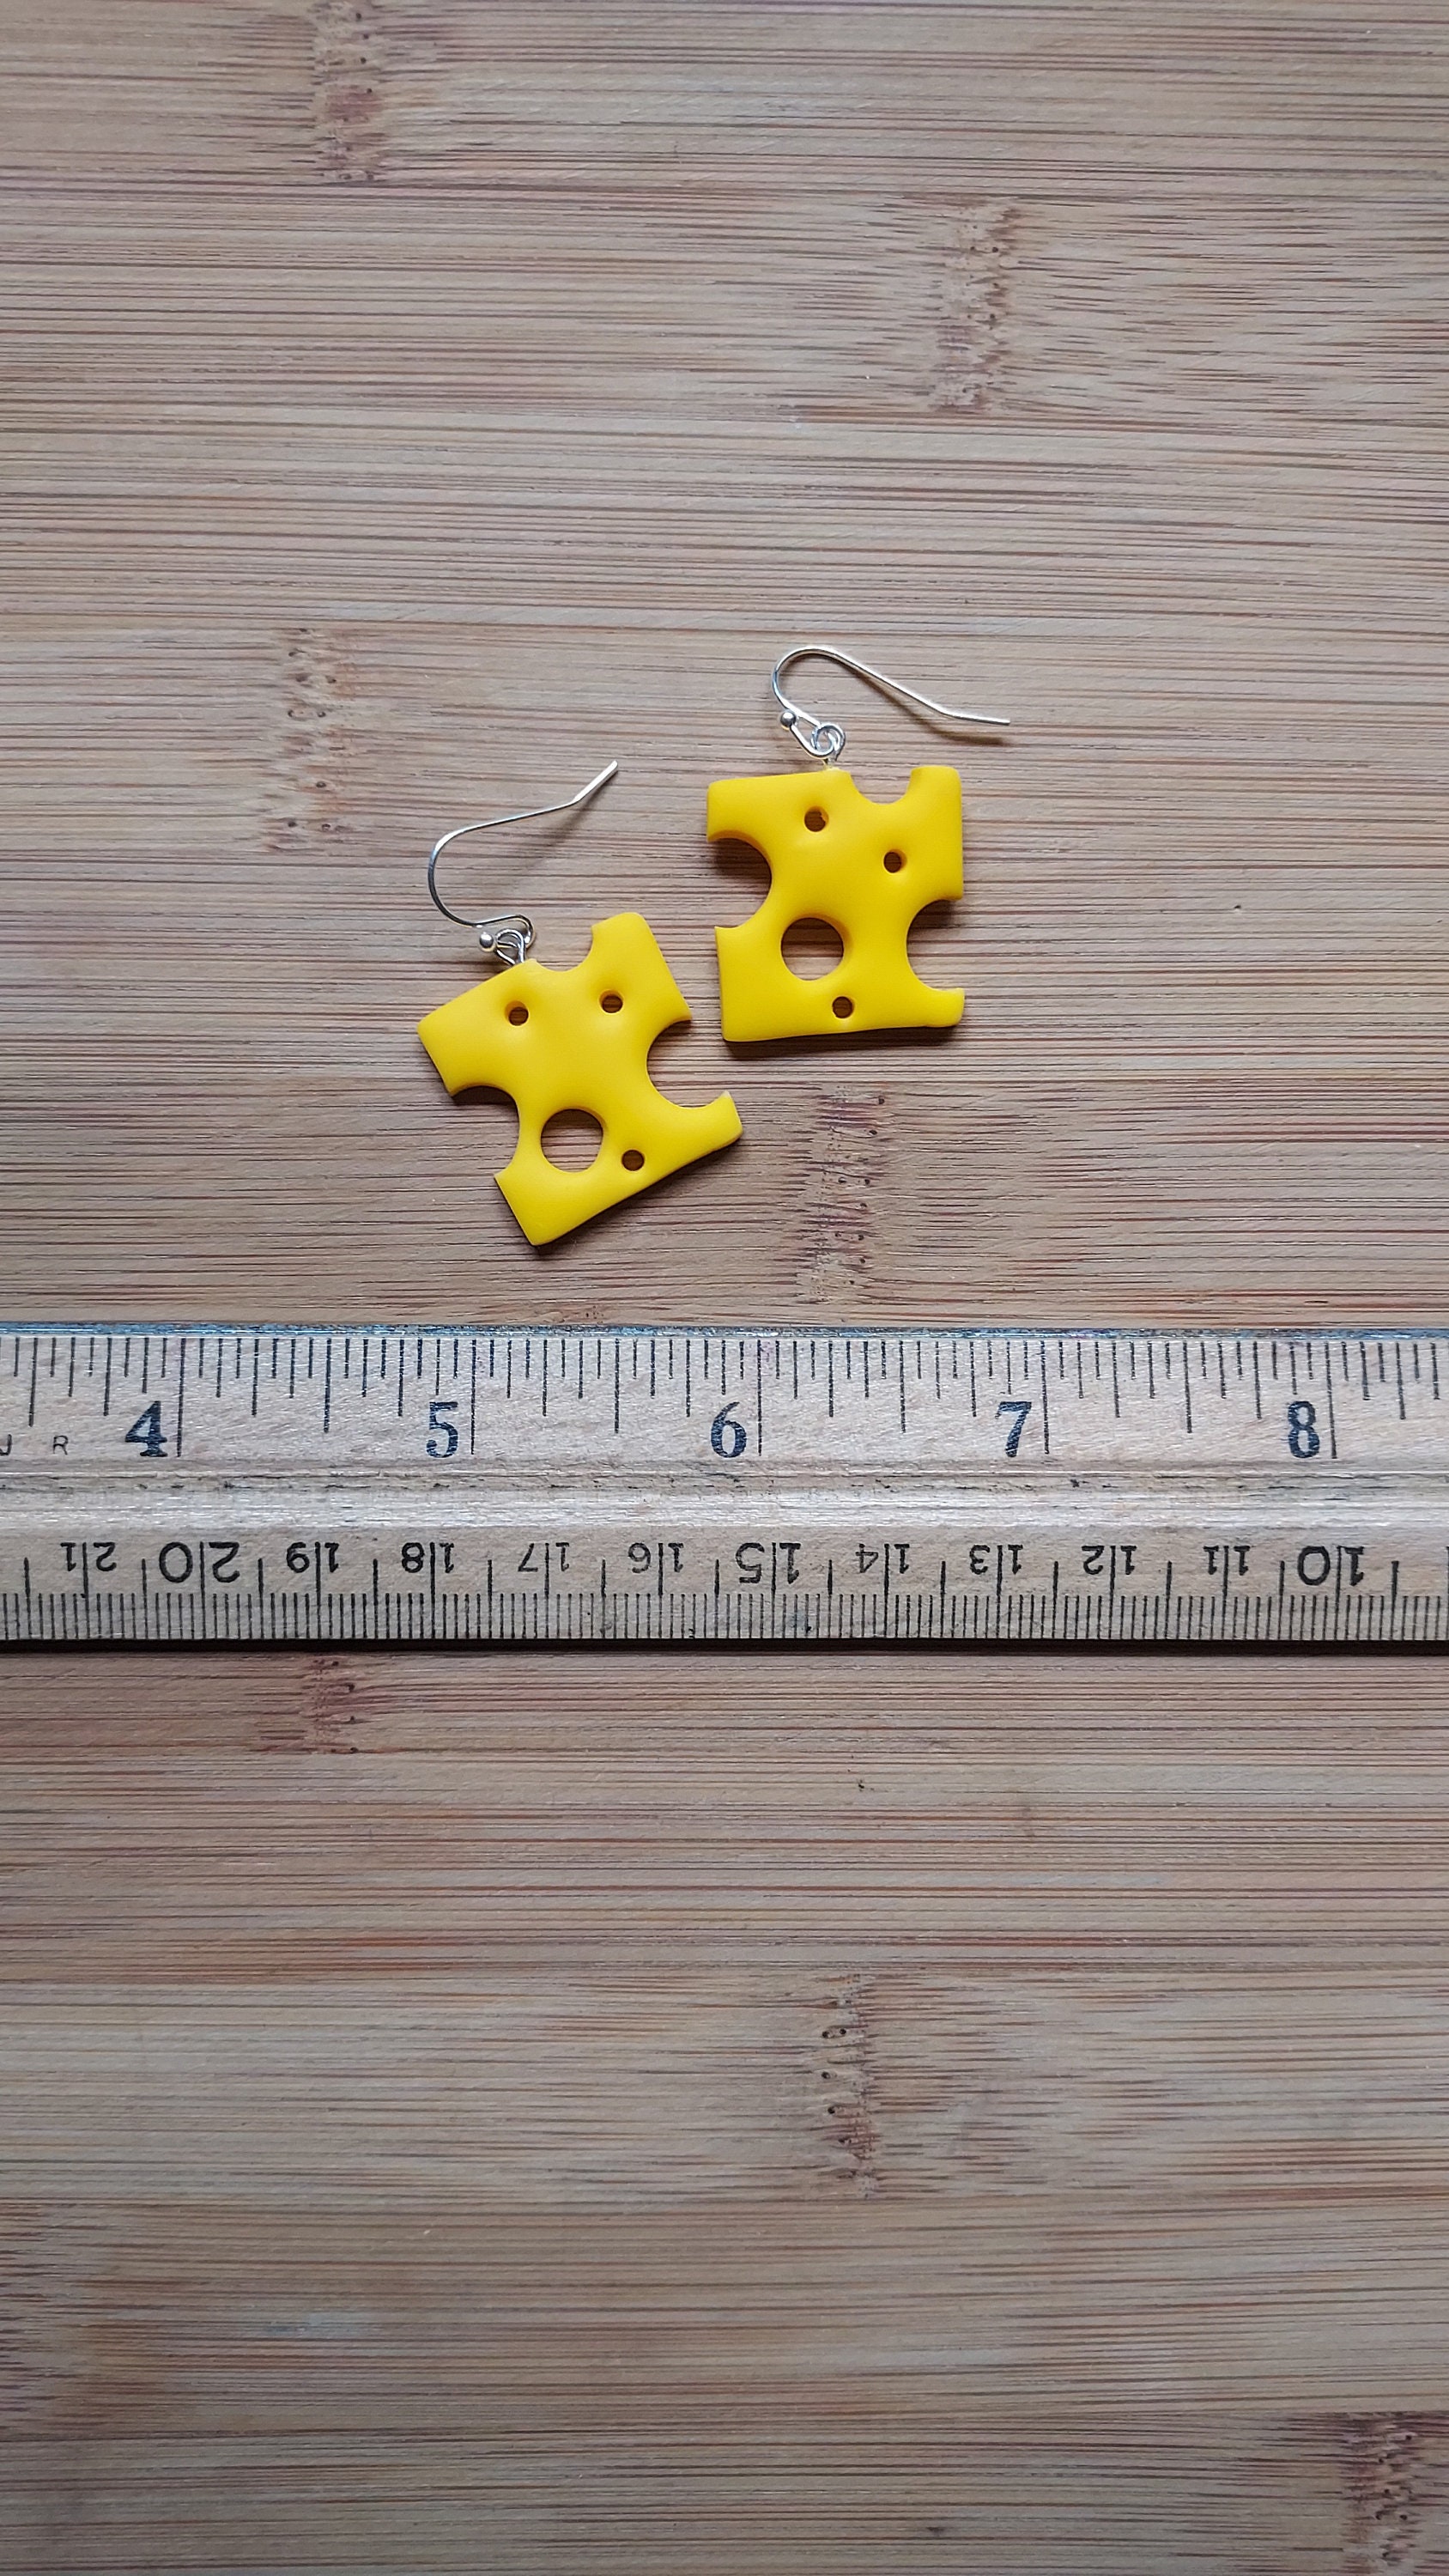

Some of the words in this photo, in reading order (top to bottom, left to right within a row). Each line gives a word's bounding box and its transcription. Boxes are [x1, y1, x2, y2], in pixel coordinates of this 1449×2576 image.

[124, 1401, 167, 1458] 4
[427, 1401, 459, 1458] 5
[711, 1401, 747, 1458] 6
[996, 1401, 1032, 1458] 7
[1288, 1400, 1320, 1458] 8
[52, 1435, 69, 1455] R
[60, 1542, 117, 1572] 21
[159, 1541, 240, 1583] 20
[286, 1542, 341, 1573] 19
[401, 1542, 455, 1573] 18
[517, 1542, 570, 1572] 17
[627, 1542, 684, 1573] 16
[736, 1542, 802, 1584] 15
[856, 1543, 911, 1575] 14
[969, 1544, 1023, 1576] 13
[1082, 1545, 1137, 1576] 12
[1203, 1545, 1251, 1576] 11
[1297, 1546, 1365, 1586] 10
